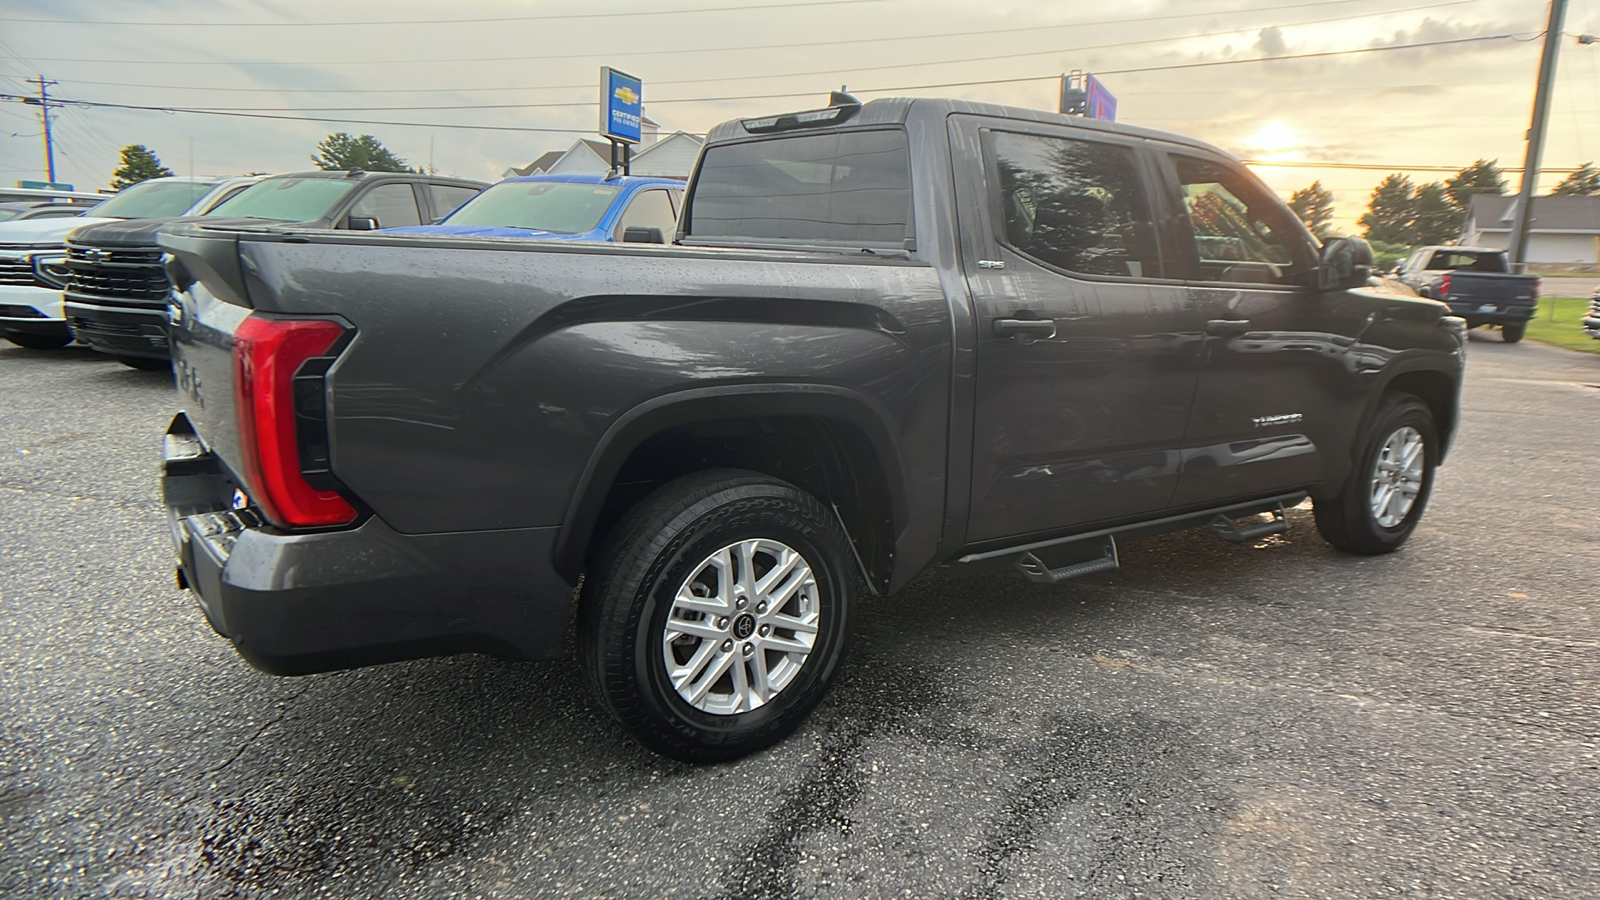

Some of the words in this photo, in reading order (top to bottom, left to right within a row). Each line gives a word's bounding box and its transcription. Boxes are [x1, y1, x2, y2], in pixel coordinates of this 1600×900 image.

[612, 110, 640, 122] CERTIFIED
[613, 116, 639, 128] PRE-OWNED
[978, 259, 1005, 269] SR5
